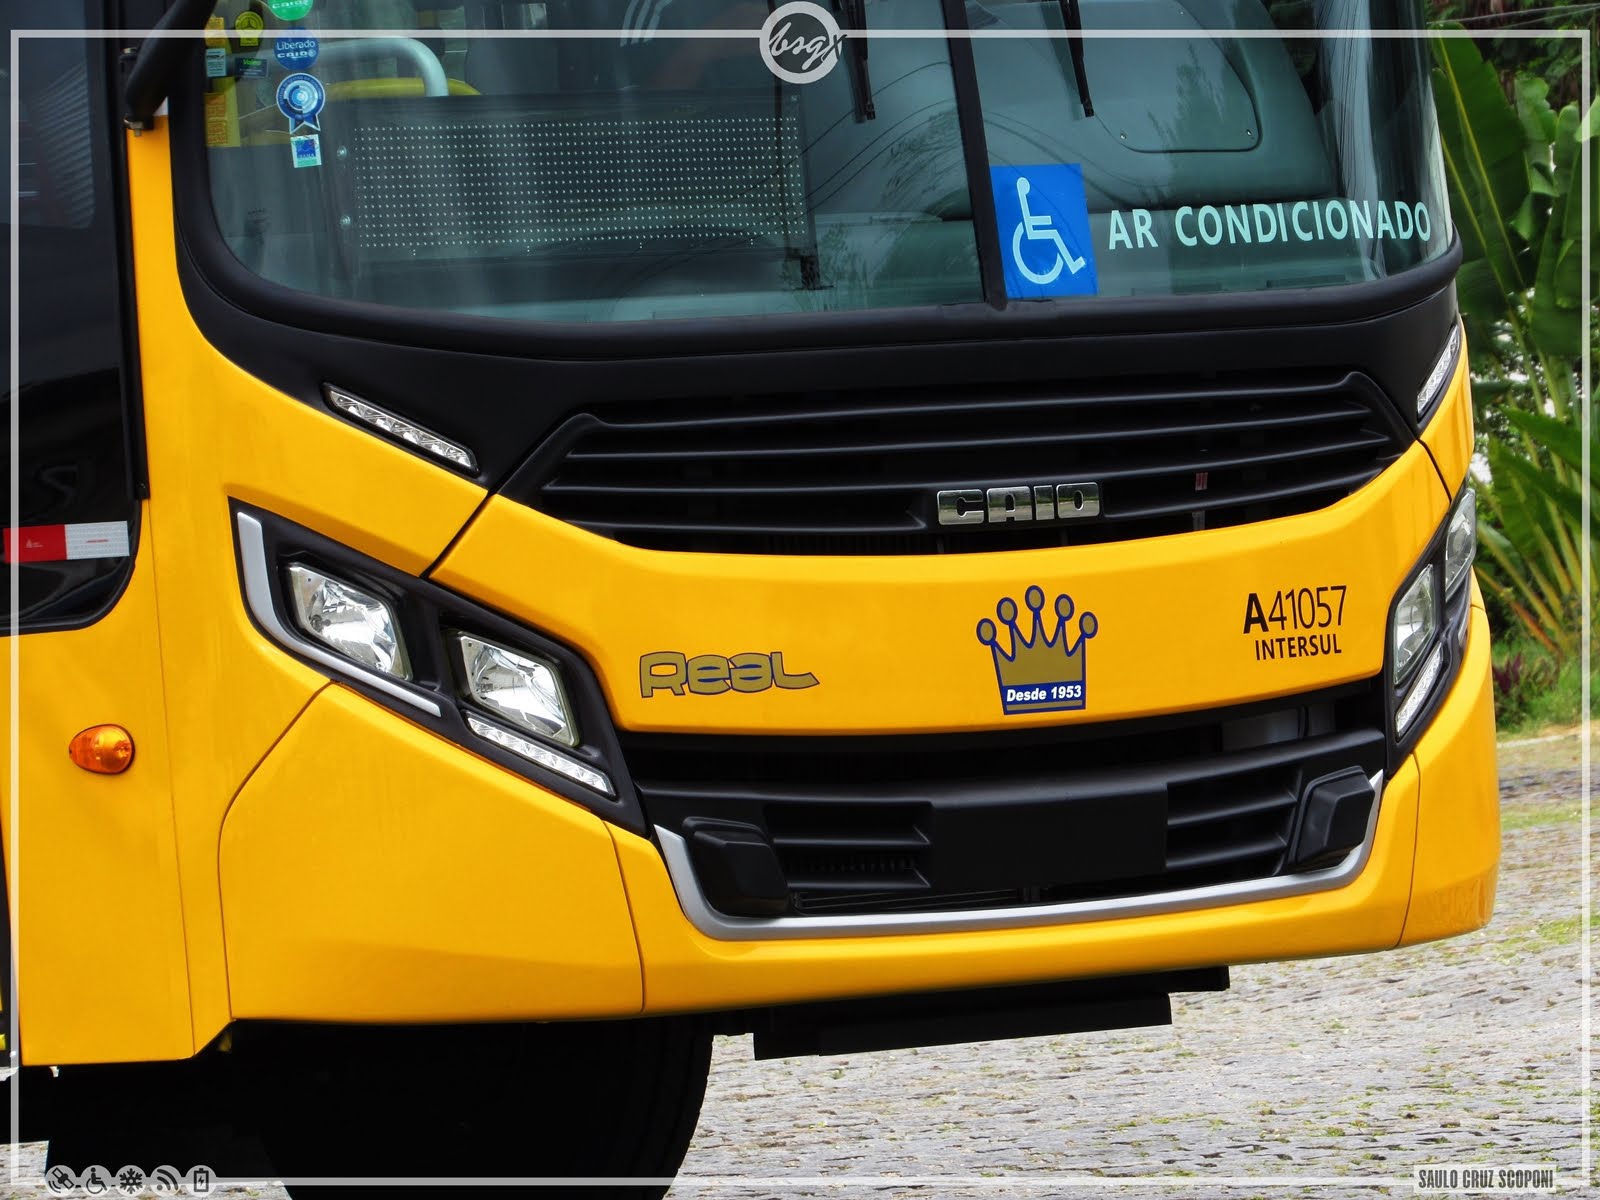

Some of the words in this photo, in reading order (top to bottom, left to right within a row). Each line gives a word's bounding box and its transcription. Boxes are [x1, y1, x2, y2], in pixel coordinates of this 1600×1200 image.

[277, 40, 316, 50] Liberado
[1109, 209, 1158, 250] AR
[1175, 200, 1431, 246] CONDICIONADO
[937, 482, 1100, 525] CAIO
[1243, 585, 1347, 634] A41057
[1255, 634, 1342, 661] INTERSUL
[1006, 688, 1047, 702] Desde
[1051, 685, 1082, 699] 1953
